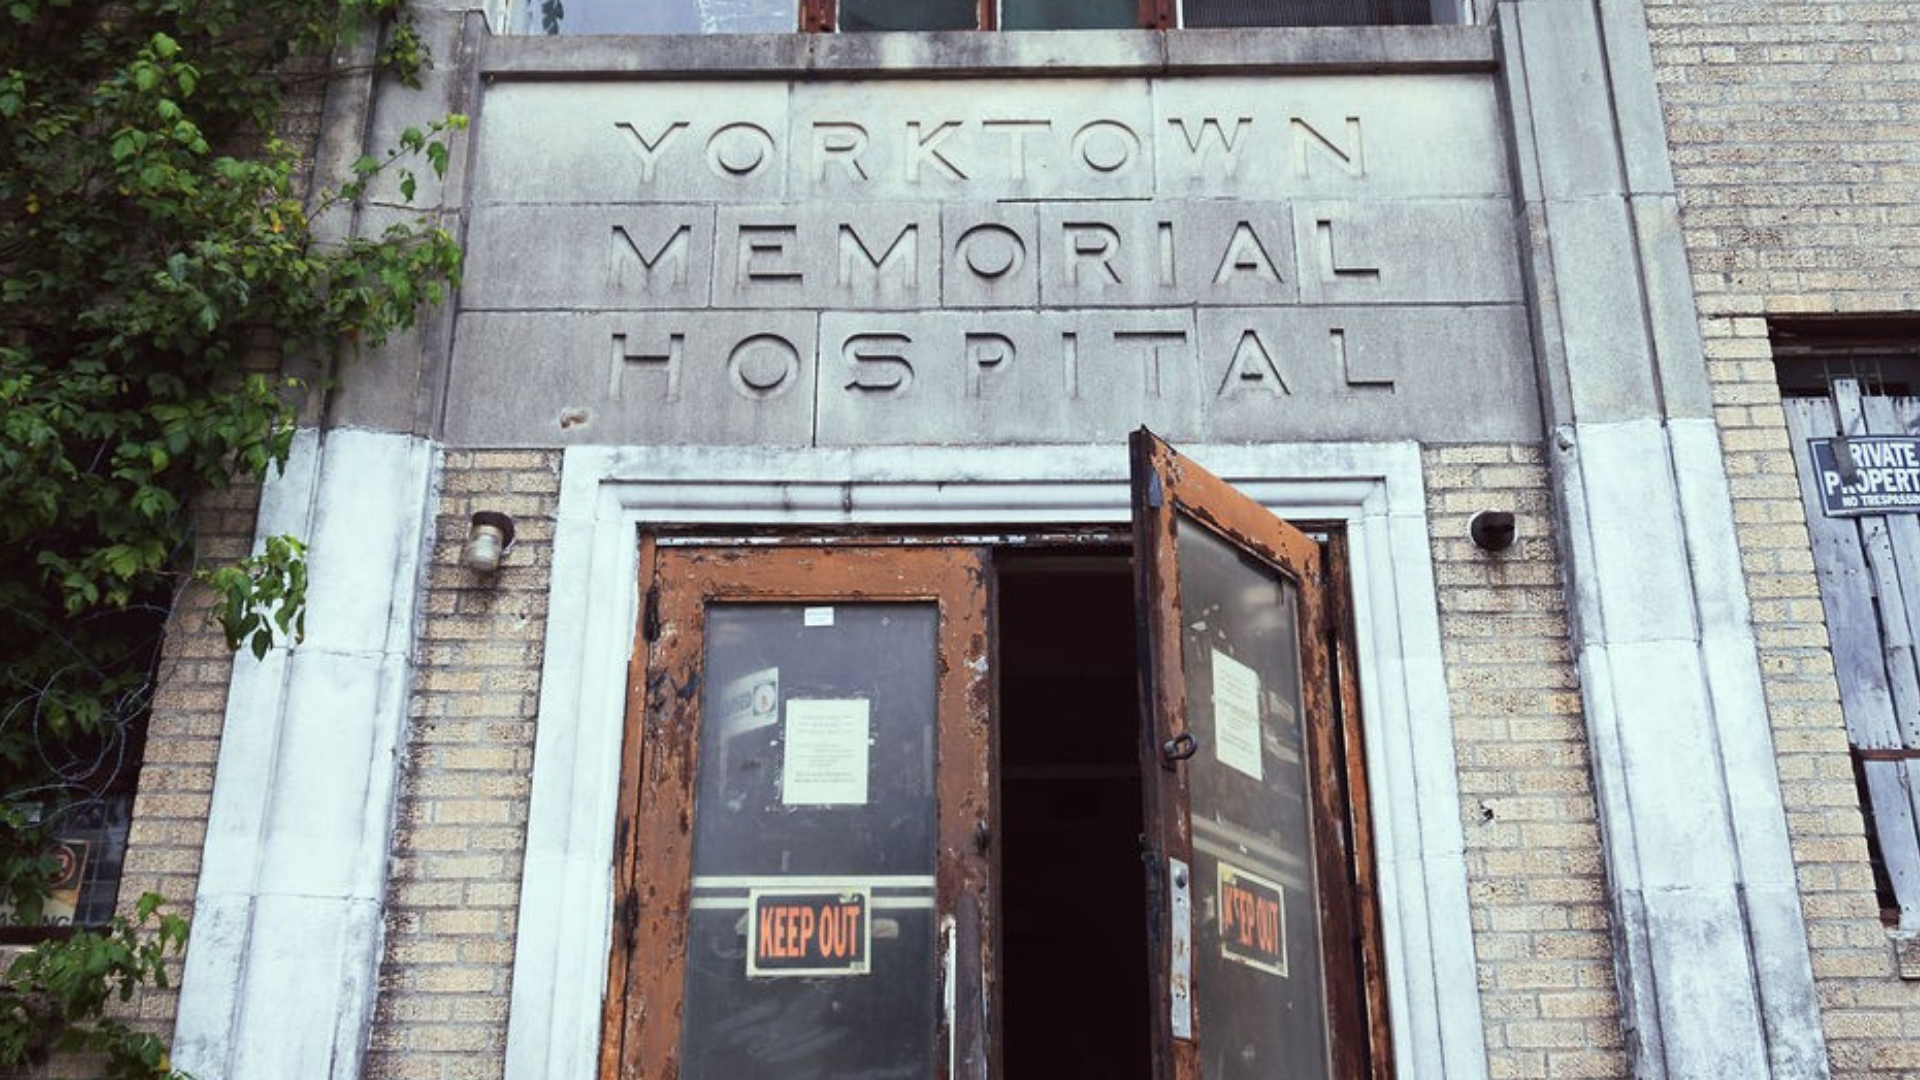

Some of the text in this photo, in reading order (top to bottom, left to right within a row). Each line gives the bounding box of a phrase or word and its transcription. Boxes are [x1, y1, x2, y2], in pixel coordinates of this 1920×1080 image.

[614, 116, 1366, 184] YORKTOWN
[608, 220, 1381, 292] MEMORIAL
[607, 327, 1395, 402] HOSPITAL
[760, 905, 861, 958] KEEP OUT
[1256, 896, 1279, 955] OUT
